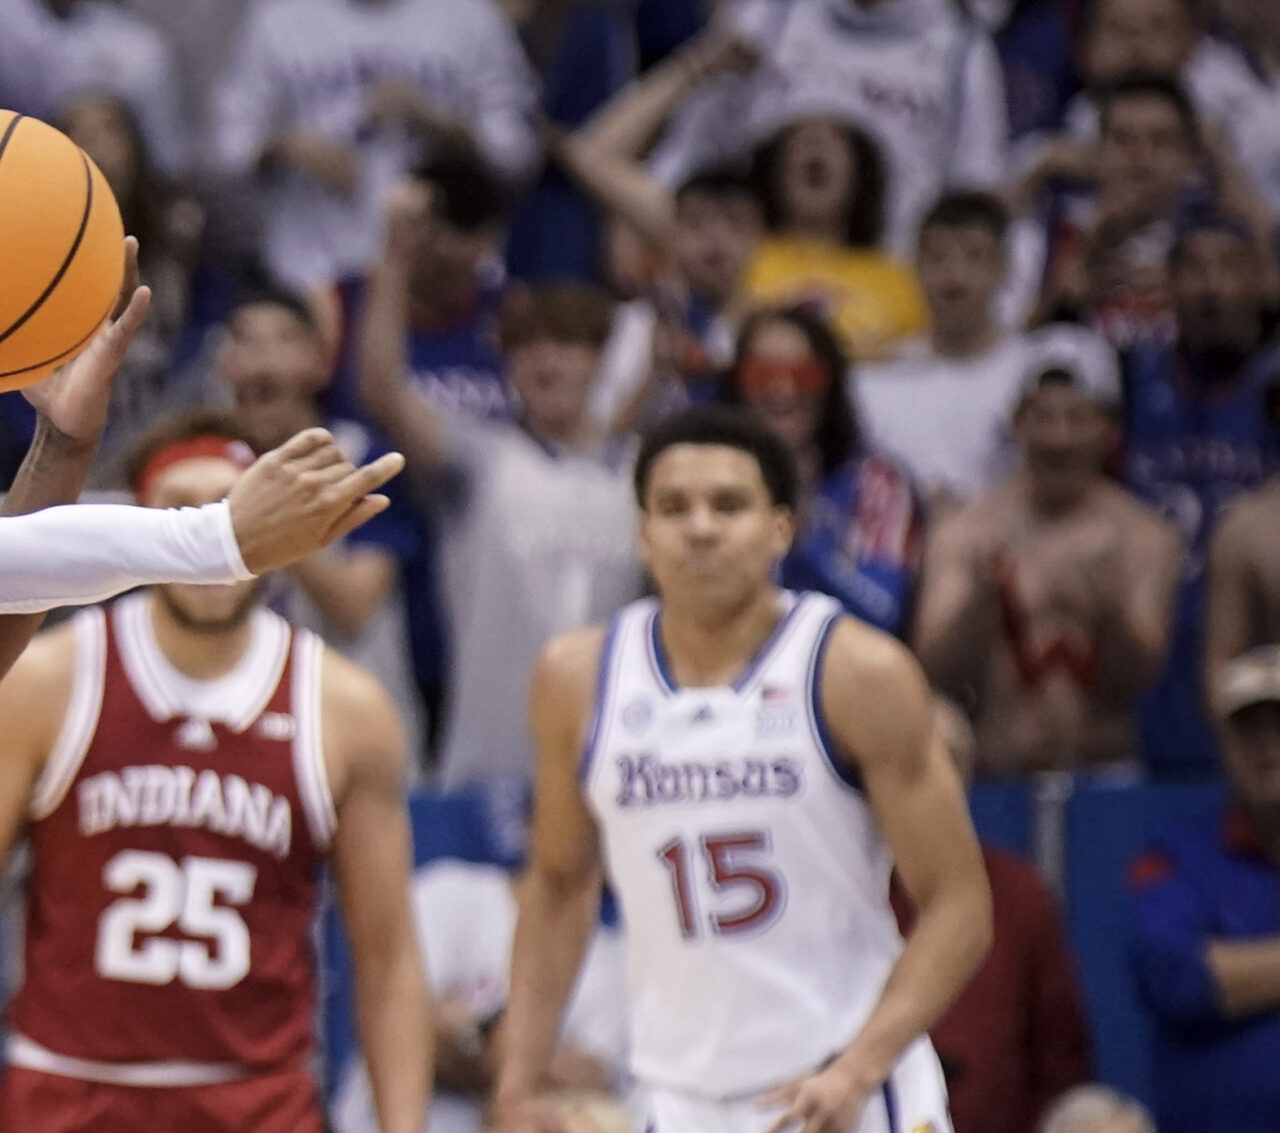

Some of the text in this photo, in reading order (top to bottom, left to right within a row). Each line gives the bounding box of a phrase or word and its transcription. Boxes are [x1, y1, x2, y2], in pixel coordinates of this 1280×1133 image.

[76, 764, 292, 860] INDIANA
[615, 753, 805, 810] Kansas
[95, 848, 259, 992] 25
[657, 828, 786, 940] 15
